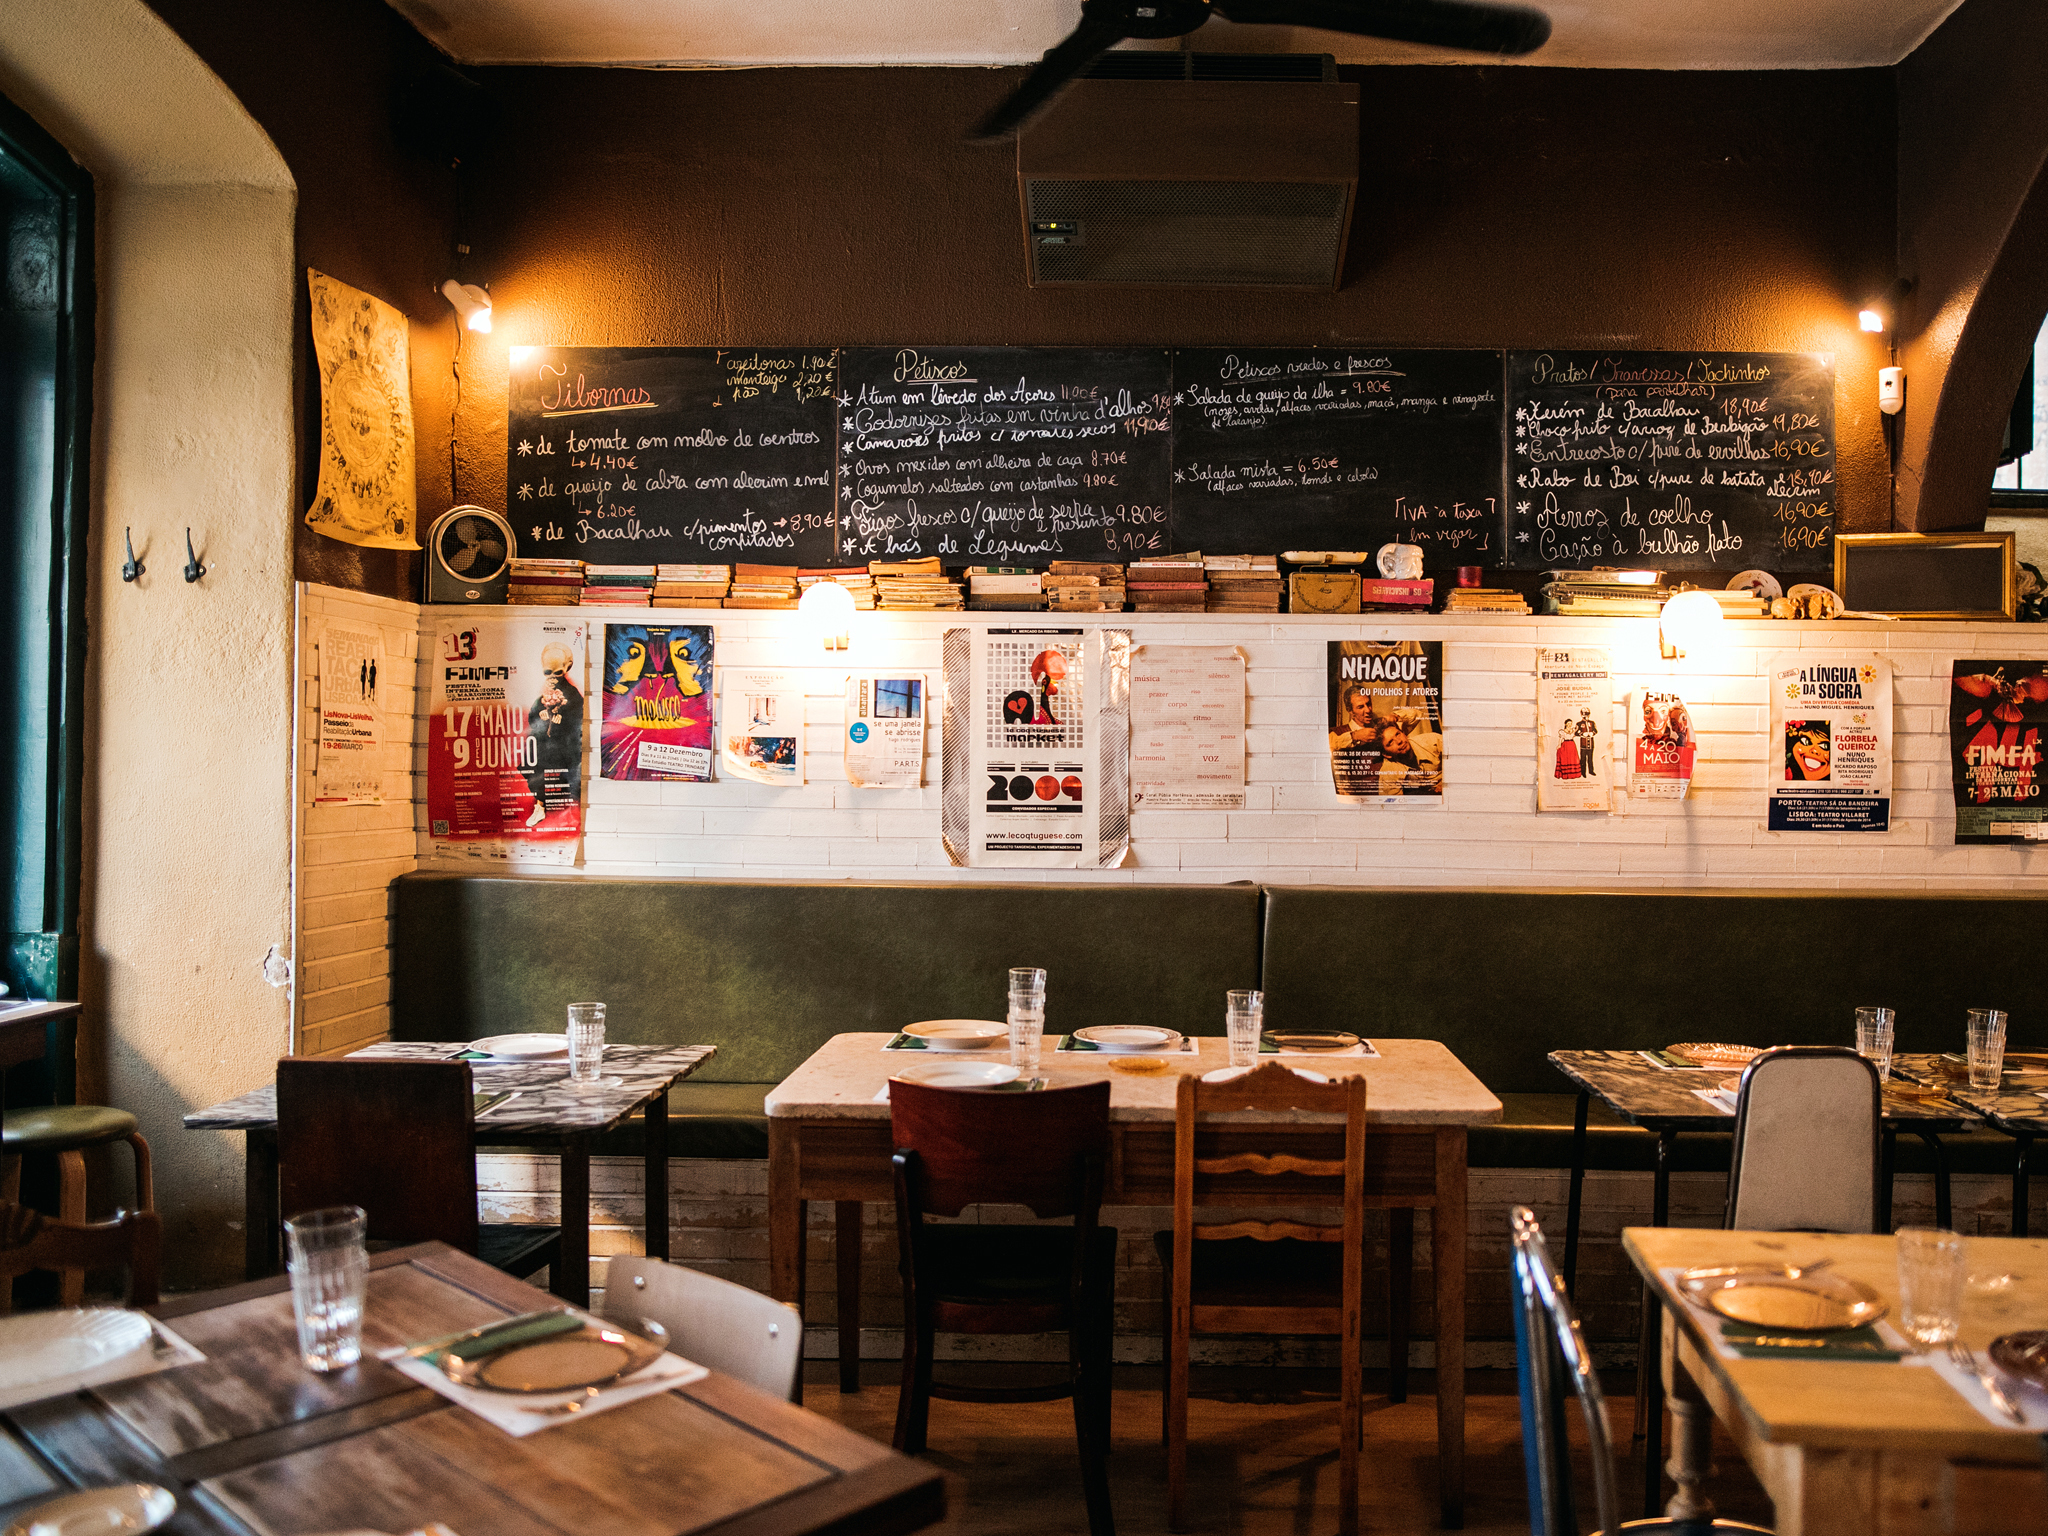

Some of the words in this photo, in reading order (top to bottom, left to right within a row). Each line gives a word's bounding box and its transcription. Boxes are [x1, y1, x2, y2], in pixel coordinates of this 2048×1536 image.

[727, 353, 795, 377] azeitonas
[894, 349, 968, 382] Petiscos
[1220, 354, 1281, 379] Petiscos
[1348, 356, 1392, 376] frescos
[1697, 358, 1770, 382] Tachinhos
[539, 363, 650, 410] Tibornas
[856, 383, 896, 406] Atum
[1010, 376, 1055, 404] Açores
[1187, 384, 1232, 407] Salada
[1255, 387, 1290, 408] queijo
[1311, 380, 1334, 399] ilha
[856, 407, 951, 435] Codornizes
[956, 401, 1001, 431] fritas
[1040, 403, 1090, 422] vinha
[1623, 399, 1701, 422] Bacalhau
[1701, 415, 1770, 441] Berbigão
[566, 429, 630, 453] tomate
[674, 428, 729, 447] molho
[759, 429, 820, 446] coentros
[856, 432, 929, 451] Camarões
[1530, 436, 1625, 463] Entrecosto
[1708, 435, 1770, 461] ervilhas
[590, 453, 639, 471] 4.40€
[897, 456, 950, 472] mexidos
[986, 454, 1031, 470] alheira
[1057, 456, 1083, 469] caça
[1188, 462, 1236, 482] Salada
[1240, 459, 1279, 478] mista
[1298, 457, 1339, 473] 6.50€
[564, 478, 612, 505] queijo
[646, 469, 688, 491] cabra
[733, 470, 788, 489] alecrim
[857, 476, 925, 504] Cogumelos
[928, 475, 984, 493] salteados
[1020, 473, 1078, 491] castanhas
[1083, 473, 1119, 488] 9.80€
[1528, 467, 1576, 488] Rabo
[1609, 465, 1640, 489] Boi
[1721, 470, 1765, 487] batata
[597, 504, 636, 519] 6.20€
[850, 499, 905, 540] Figos
[907, 498, 957, 538] frescos
[982, 502, 1026, 533] queijo
[1115, 504, 1167, 524] 9.80€
[1403, 504, 1429, 521] IVA
[1452, 502, 1483, 520] taxa
[1649, 493, 1713, 526] coelho
[1773, 501, 1834, 524] 16,90€
[575, 519, 673, 543] Bacalhau
[708, 531, 794, 551] confitados
[1540, 527, 1603, 565] Cação
[1637, 527, 1699, 554] bulhão
[1705, 520, 1743, 562] pato
[968, 528, 1063, 561] Legumes
[1104, 528, 1163, 552] 8,90€
[446, 666, 509, 681] FIMFA
[1134, 674, 1160, 682] música
[1341, 656, 1428, 681] NHAQUE
[1799, 670, 1806, 682] A
[1810, 664, 1857, 683] LÍNGUA
[1148, 691, 1169, 699] prazer
[1360, 688, 1371, 696] OU
[1373, 687, 1403, 696] PIOLHOS
[1405, 687, 1410, 696] E
[1412, 687, 1439, 696] ATORES
[1803, 683, 1816, 695] DA
[1818, 683, 1862, 699] SOGRA
[1167, 701, 1188, 709] corpo
[443, 706, 473, 738] 17
[480, 704, 524, 736] MAIO
[901, 720, 921, 729] janela
[1640, 740, 1648, 750] 4
[1658, 741, 1677, 753] 20
[1835, 735, 1878, 743] FLORBELA
[1837, 743, 1876, 751] QUEIROZ
[453, 738, 470, 770] 9
[475, 736, 538, 769] JUNHO
[669, 747, 703, 758] Dezembro
[1643, 752, 1680, 765] MAIO
[1965, 744, 2036, 767] FIMFA
[1966, 770, 2037, 779] INTERNACIONAL
[987, 775, 1083, 801] 2009
[1983, 786, 1999, 799] 25
[2000, 784, 2040, 798] MAIO
[986, 831, 1083, 841] www.lecoqtuguese.com
